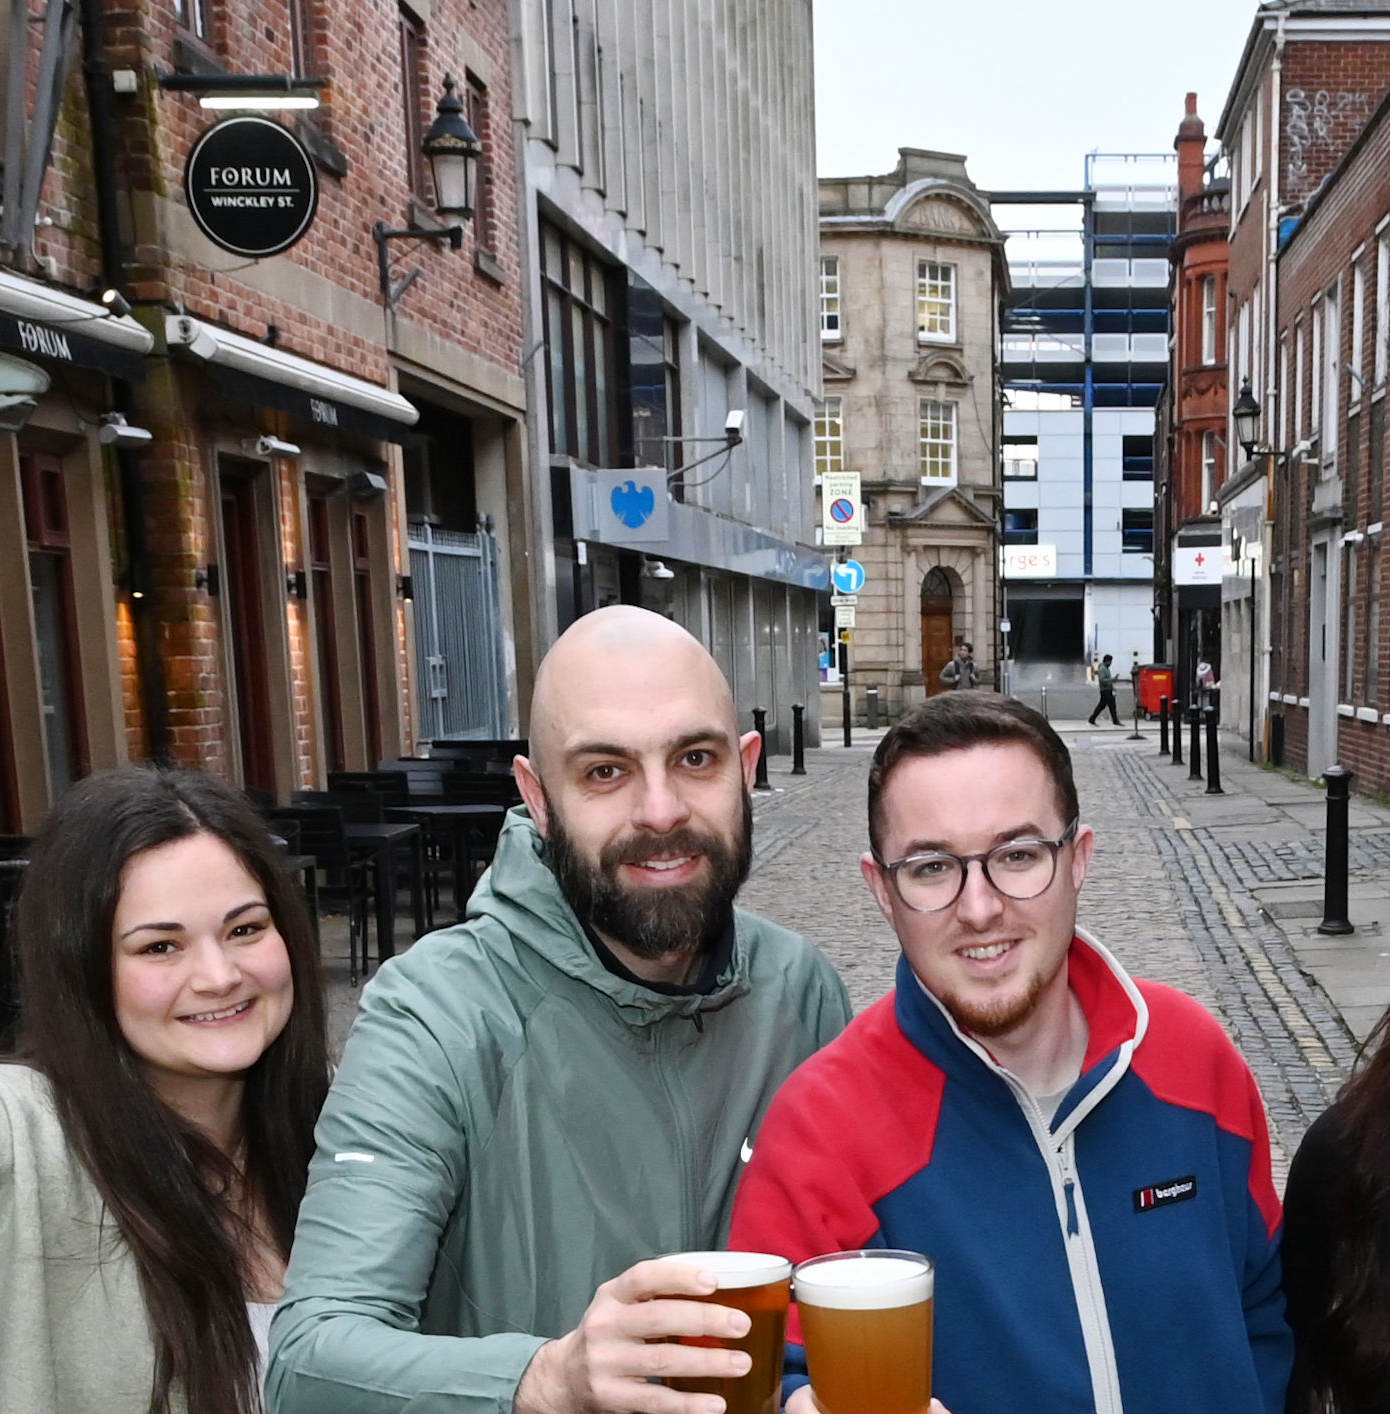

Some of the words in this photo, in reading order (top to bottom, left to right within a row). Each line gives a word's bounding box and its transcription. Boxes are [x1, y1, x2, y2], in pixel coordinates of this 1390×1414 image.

[210, 167, 291, 186] FORUM
[210, 196, 275, 208] WINCKLEY
[277, 196, 294, 208] ST.
[17, 320, 73, 361] FORUM
